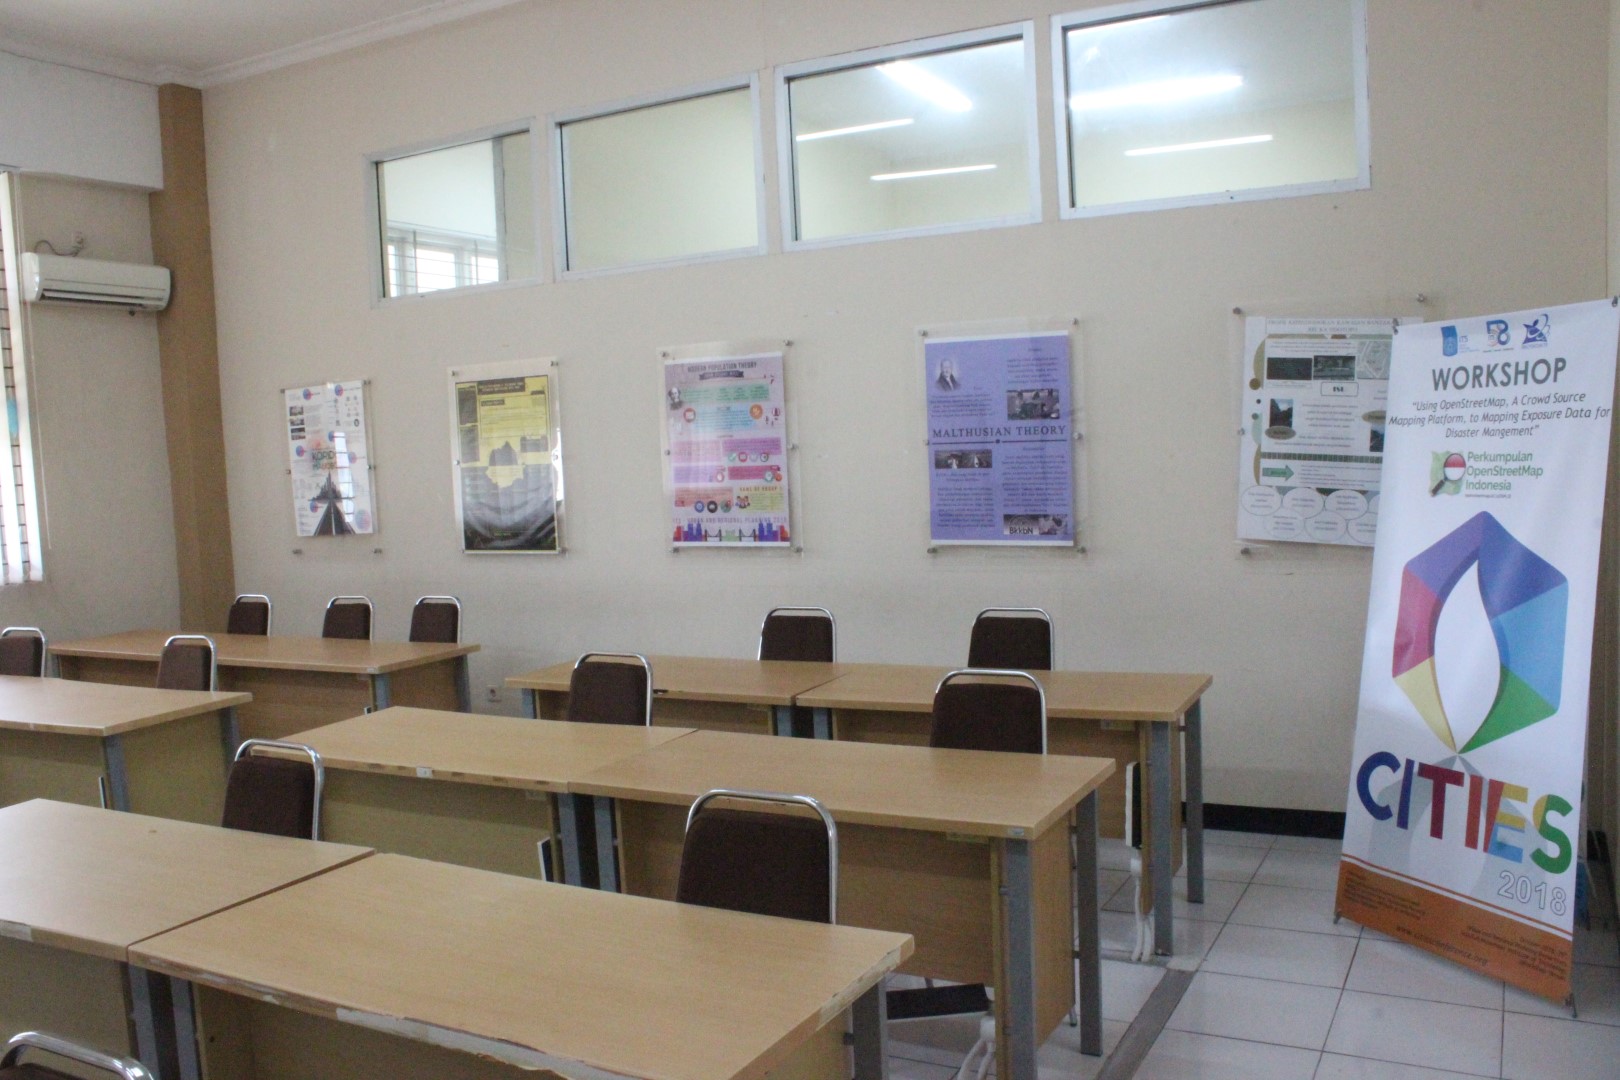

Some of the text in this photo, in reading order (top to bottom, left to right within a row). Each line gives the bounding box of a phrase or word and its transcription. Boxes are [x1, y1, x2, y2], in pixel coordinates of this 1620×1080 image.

[1432, 357, 1567, 391] WORKSHOP
[1440, 397, 1509, 411] OpenStreetMap,
[1511, 396, 1518, 406] A
[1521, 393, 1551, 406] Crowd
[1553, 392, 1586, 404] Source
[1389, 406, 1611, 427] Mapping Platform, to Mapping Exposure Data for
[932, 425, 1066, 438] MALTHUSIAN THEORY
[1445, 427, 1480, 438] Disaster
[1467, 450, 1533, 464] Perkumpulan
[1466, 465, 1544, 479] OpenStreetMap
[1465, 479, 1512, 491] Indonesia
[1356, 751, 1573, 875] CITIES
[1497, 870, 1567, 916] 2018
